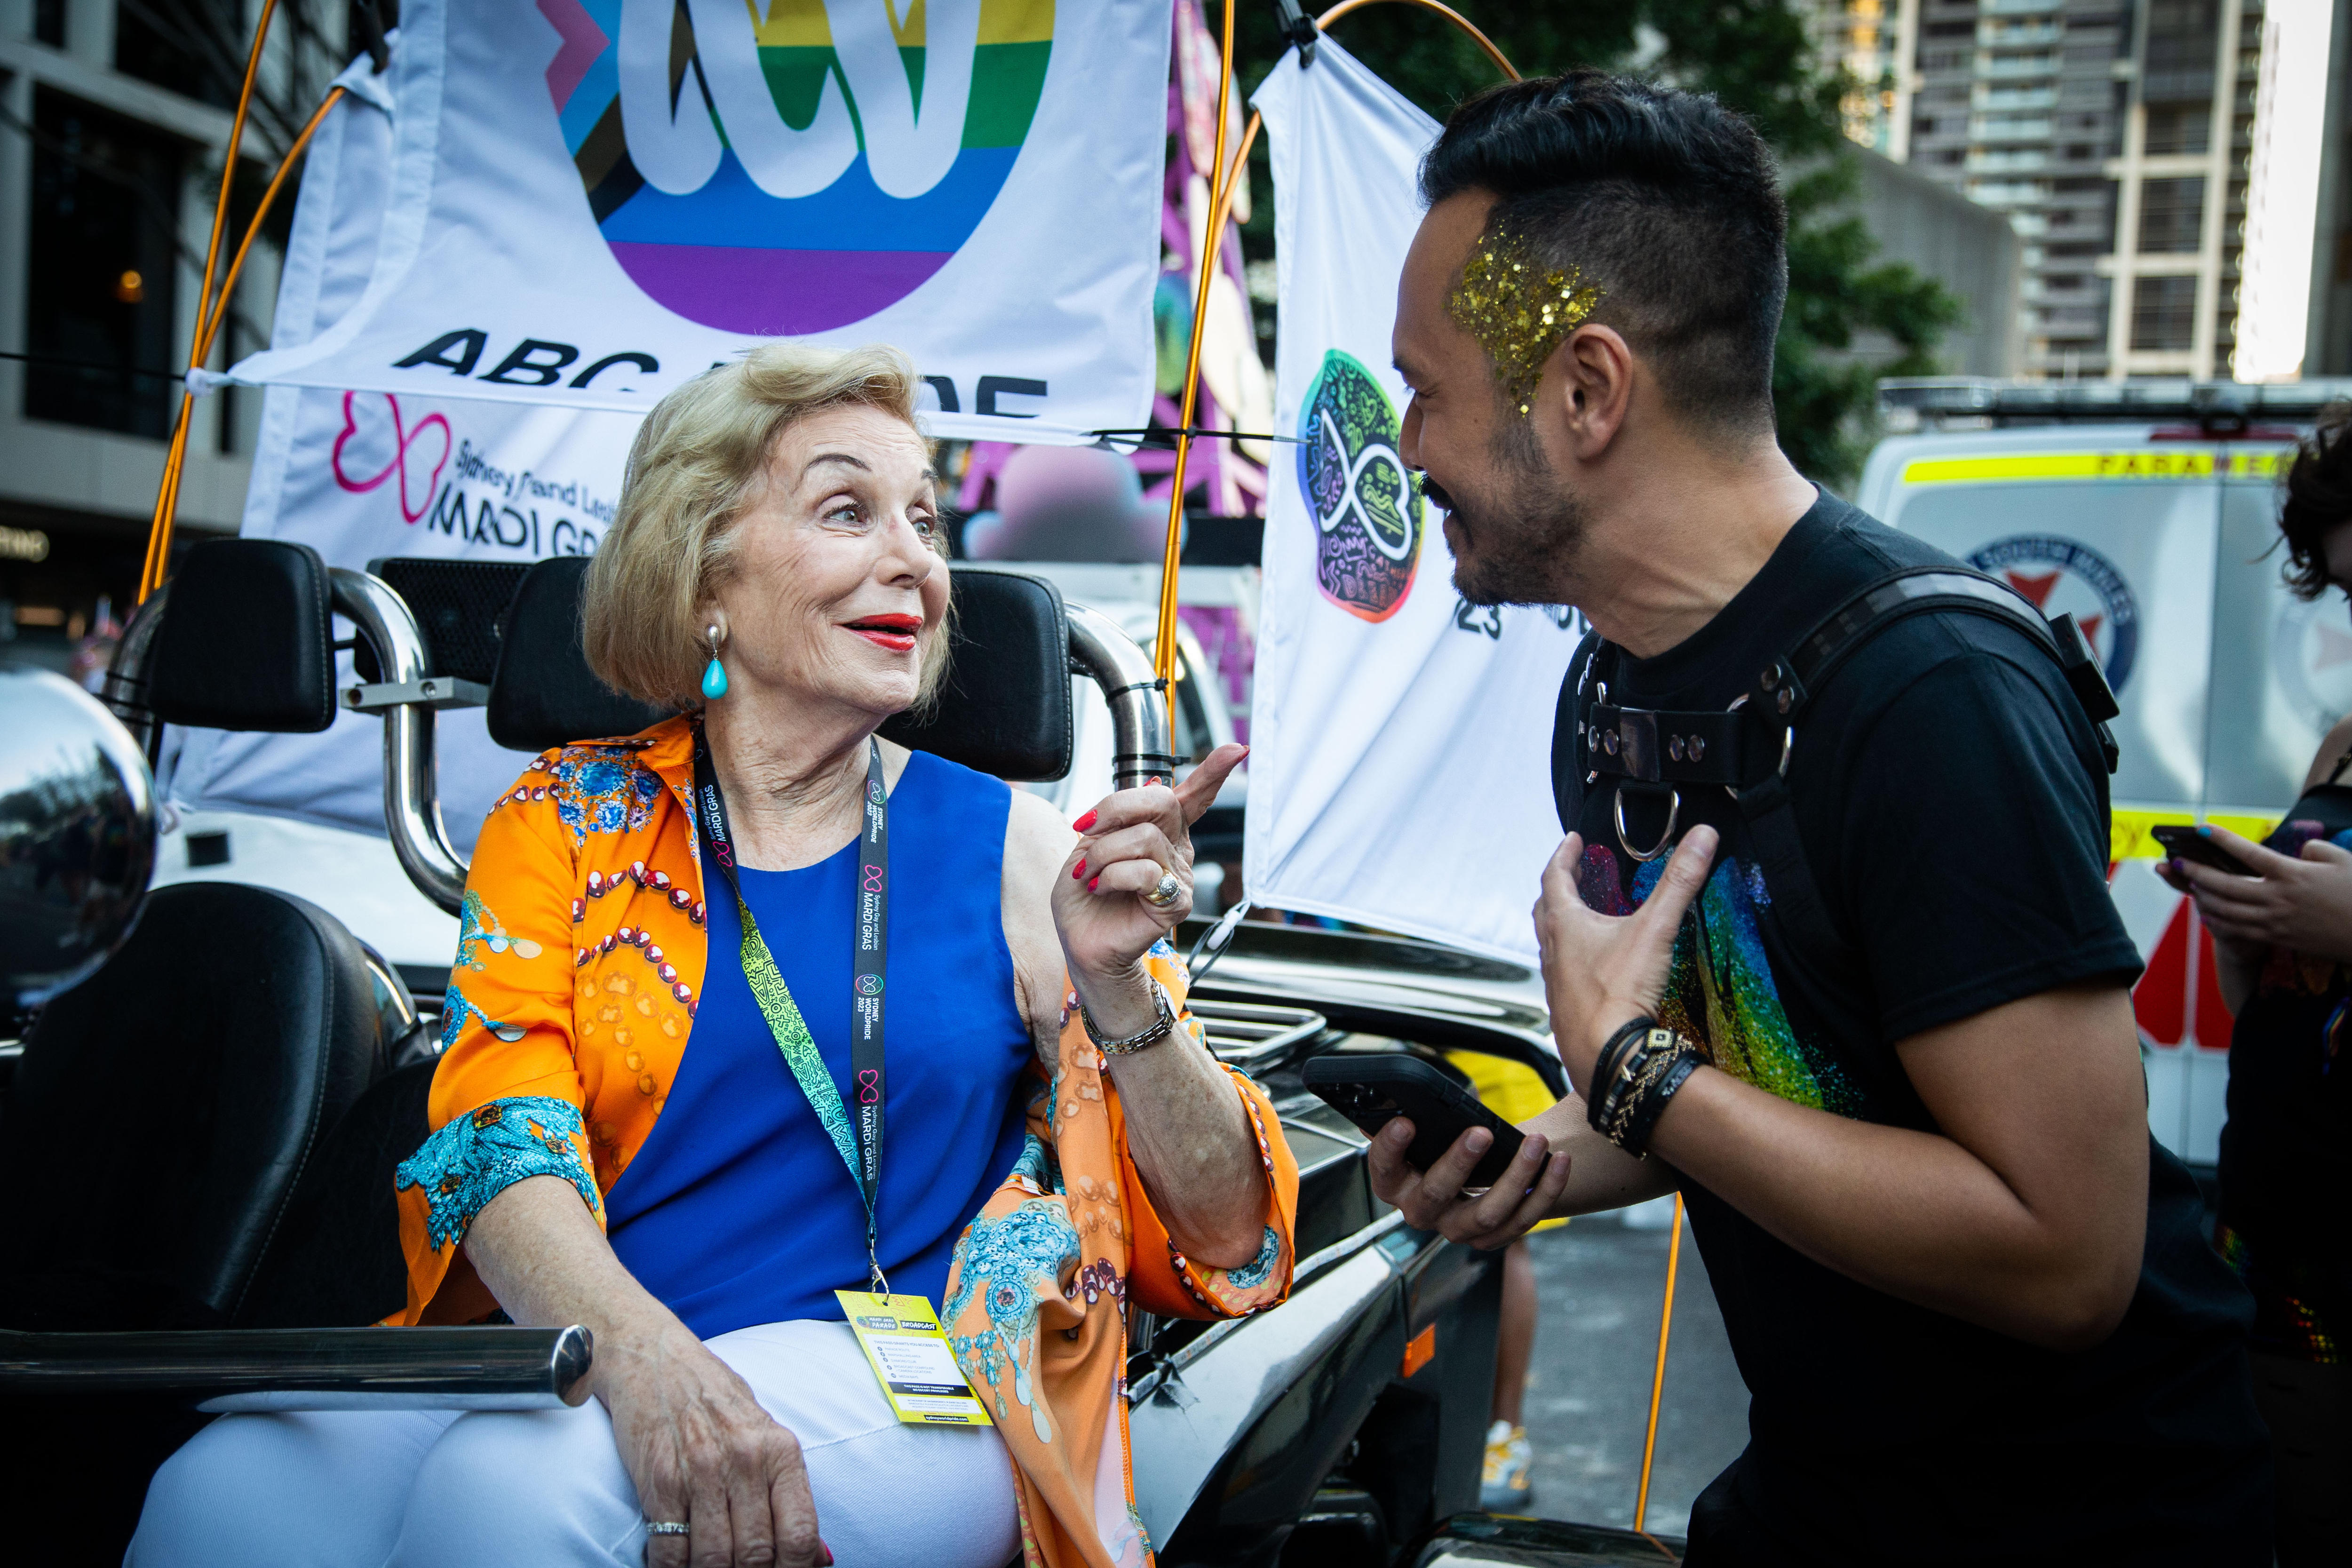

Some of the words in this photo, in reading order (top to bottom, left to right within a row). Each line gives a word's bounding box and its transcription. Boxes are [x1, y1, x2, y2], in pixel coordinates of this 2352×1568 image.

[704, 784, 718, 811] GRAS
[707, 826, 715, 840] Sydney
[710, 812, 727, 841] MARDI
[862, 892, 873, 923] MARDI
[862, 925, 873, 950] GRAS
[862, 1106, 871, 1146] MARDI
[864, 1147, 873, 1181] GRAS
